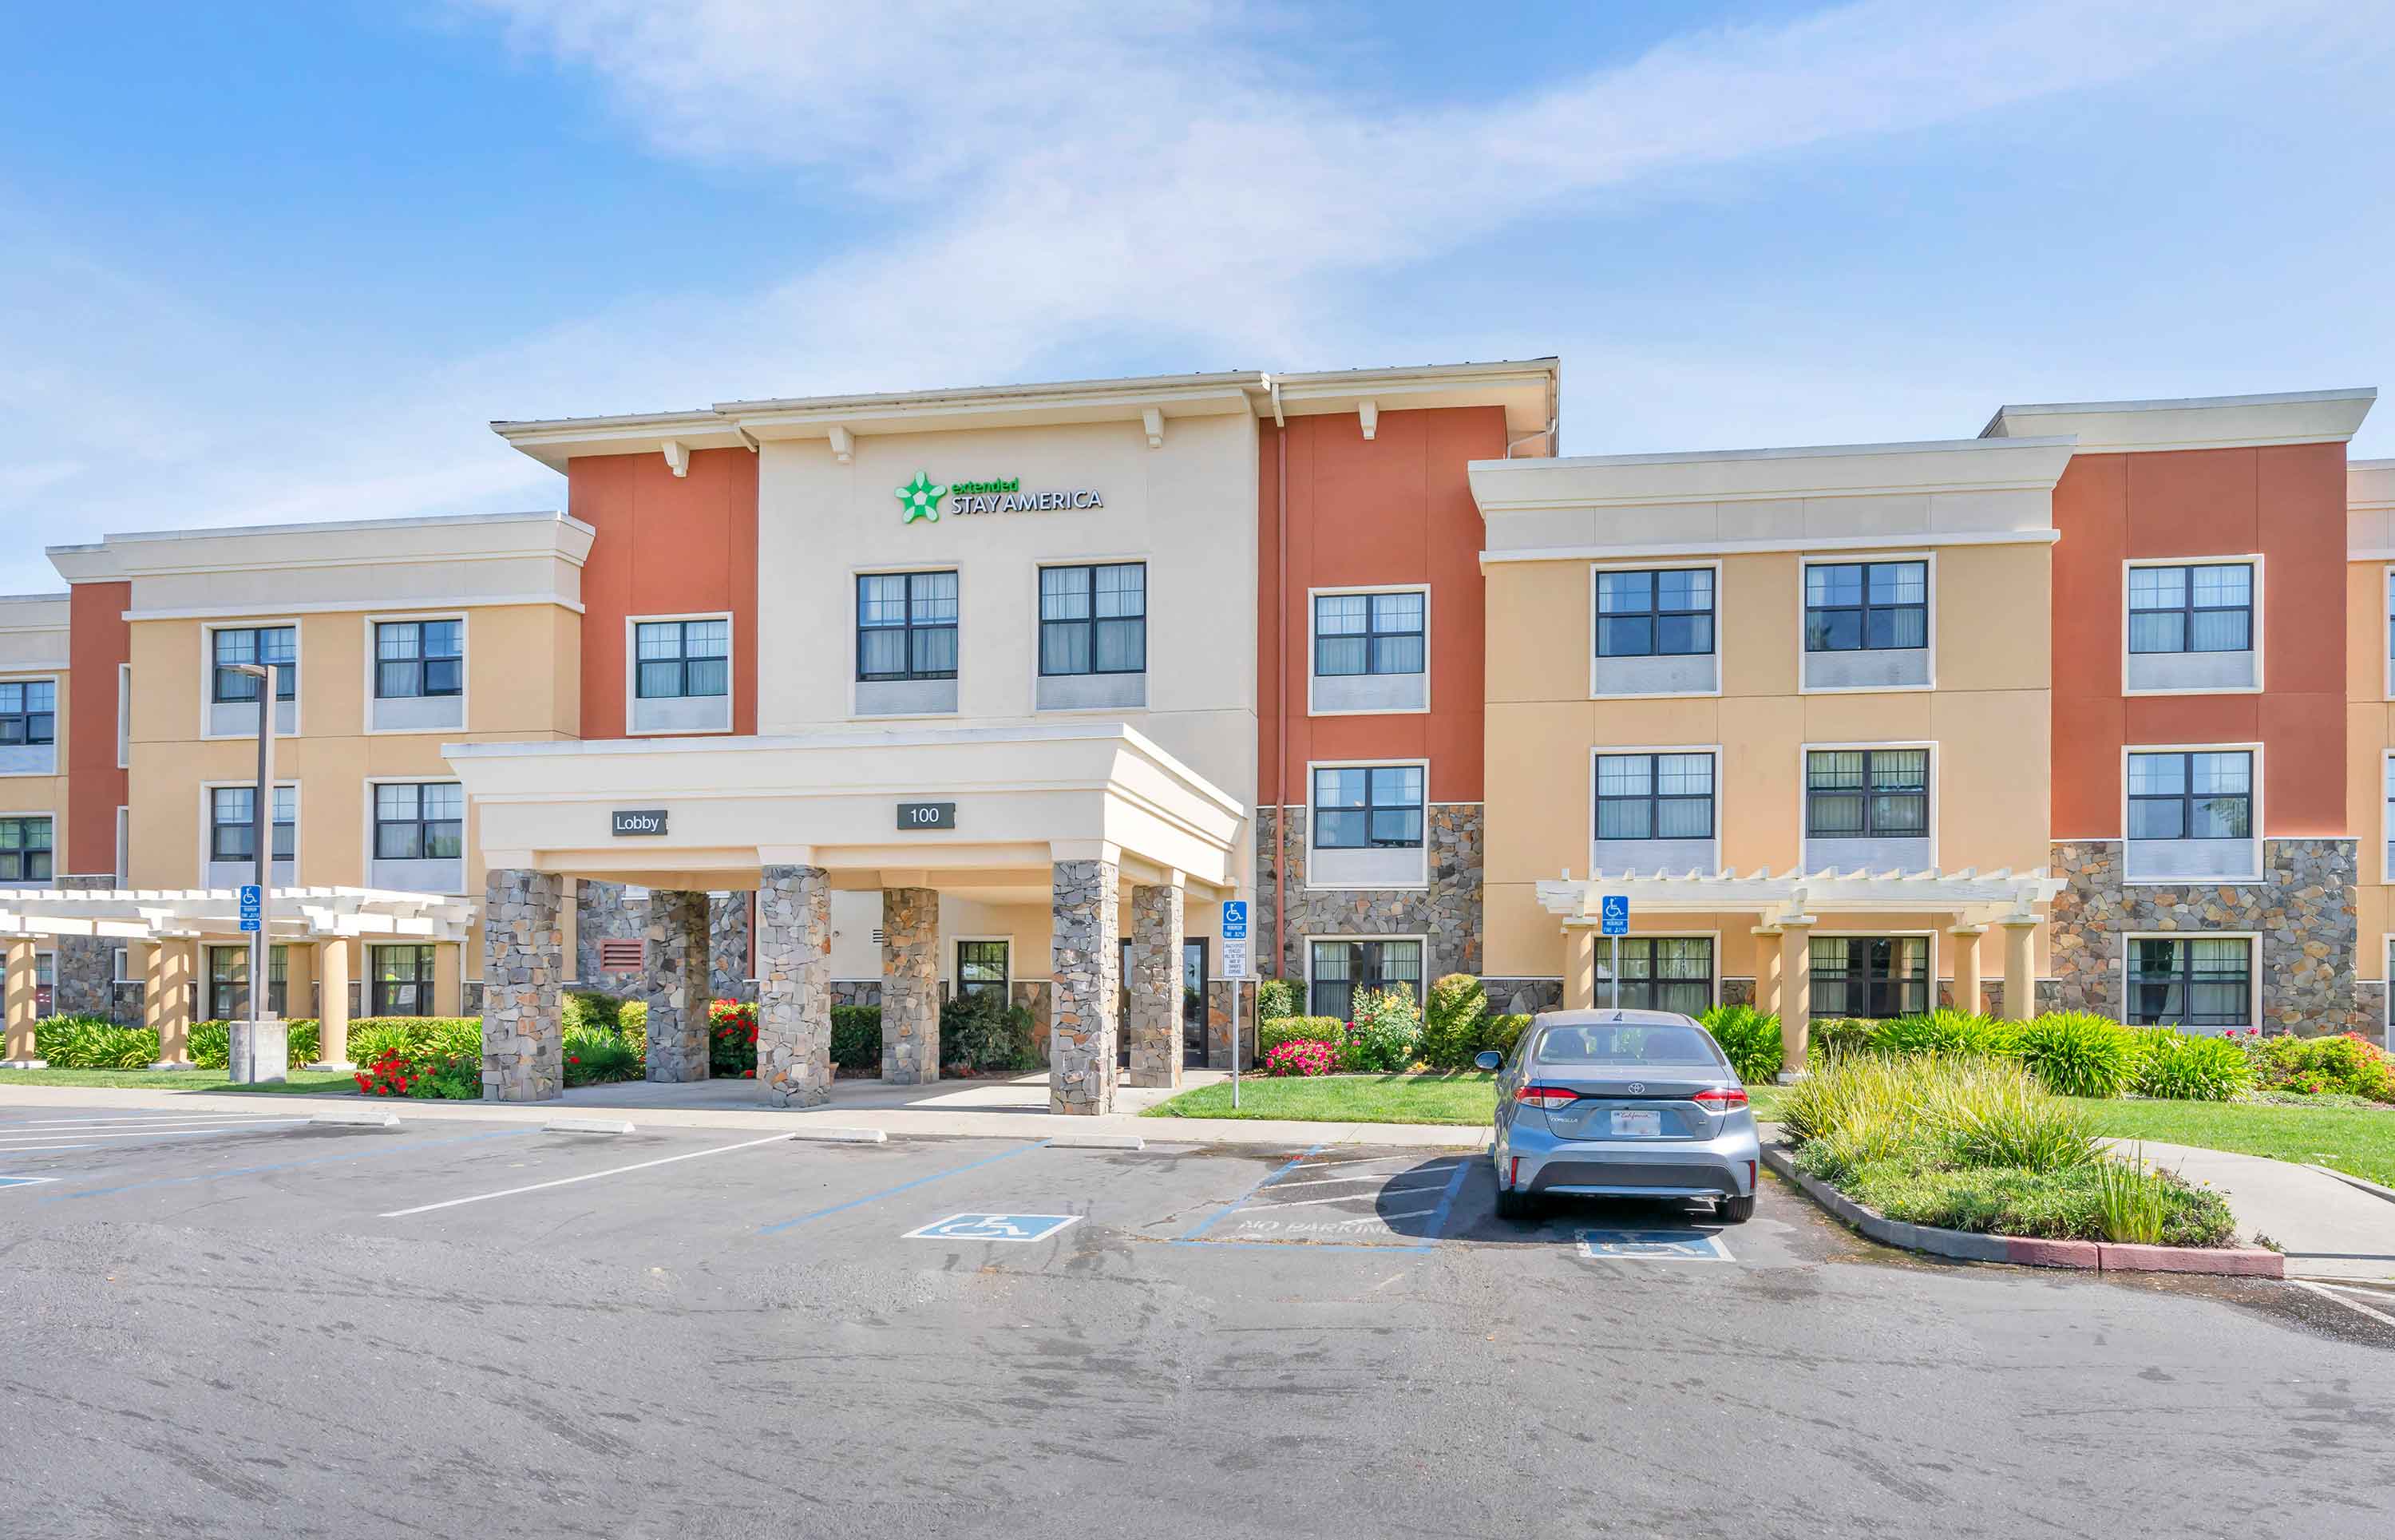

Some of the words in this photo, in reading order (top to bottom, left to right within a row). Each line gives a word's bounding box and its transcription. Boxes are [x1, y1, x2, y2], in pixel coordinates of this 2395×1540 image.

[951, 477, 1019, 494] extended
[951, 495, 1001, 515] STAY
[1002, 489, 1103, 513] AMERICA
[616, 815, 659, 832] Lobby
[910, 808, 939, 822] 100
